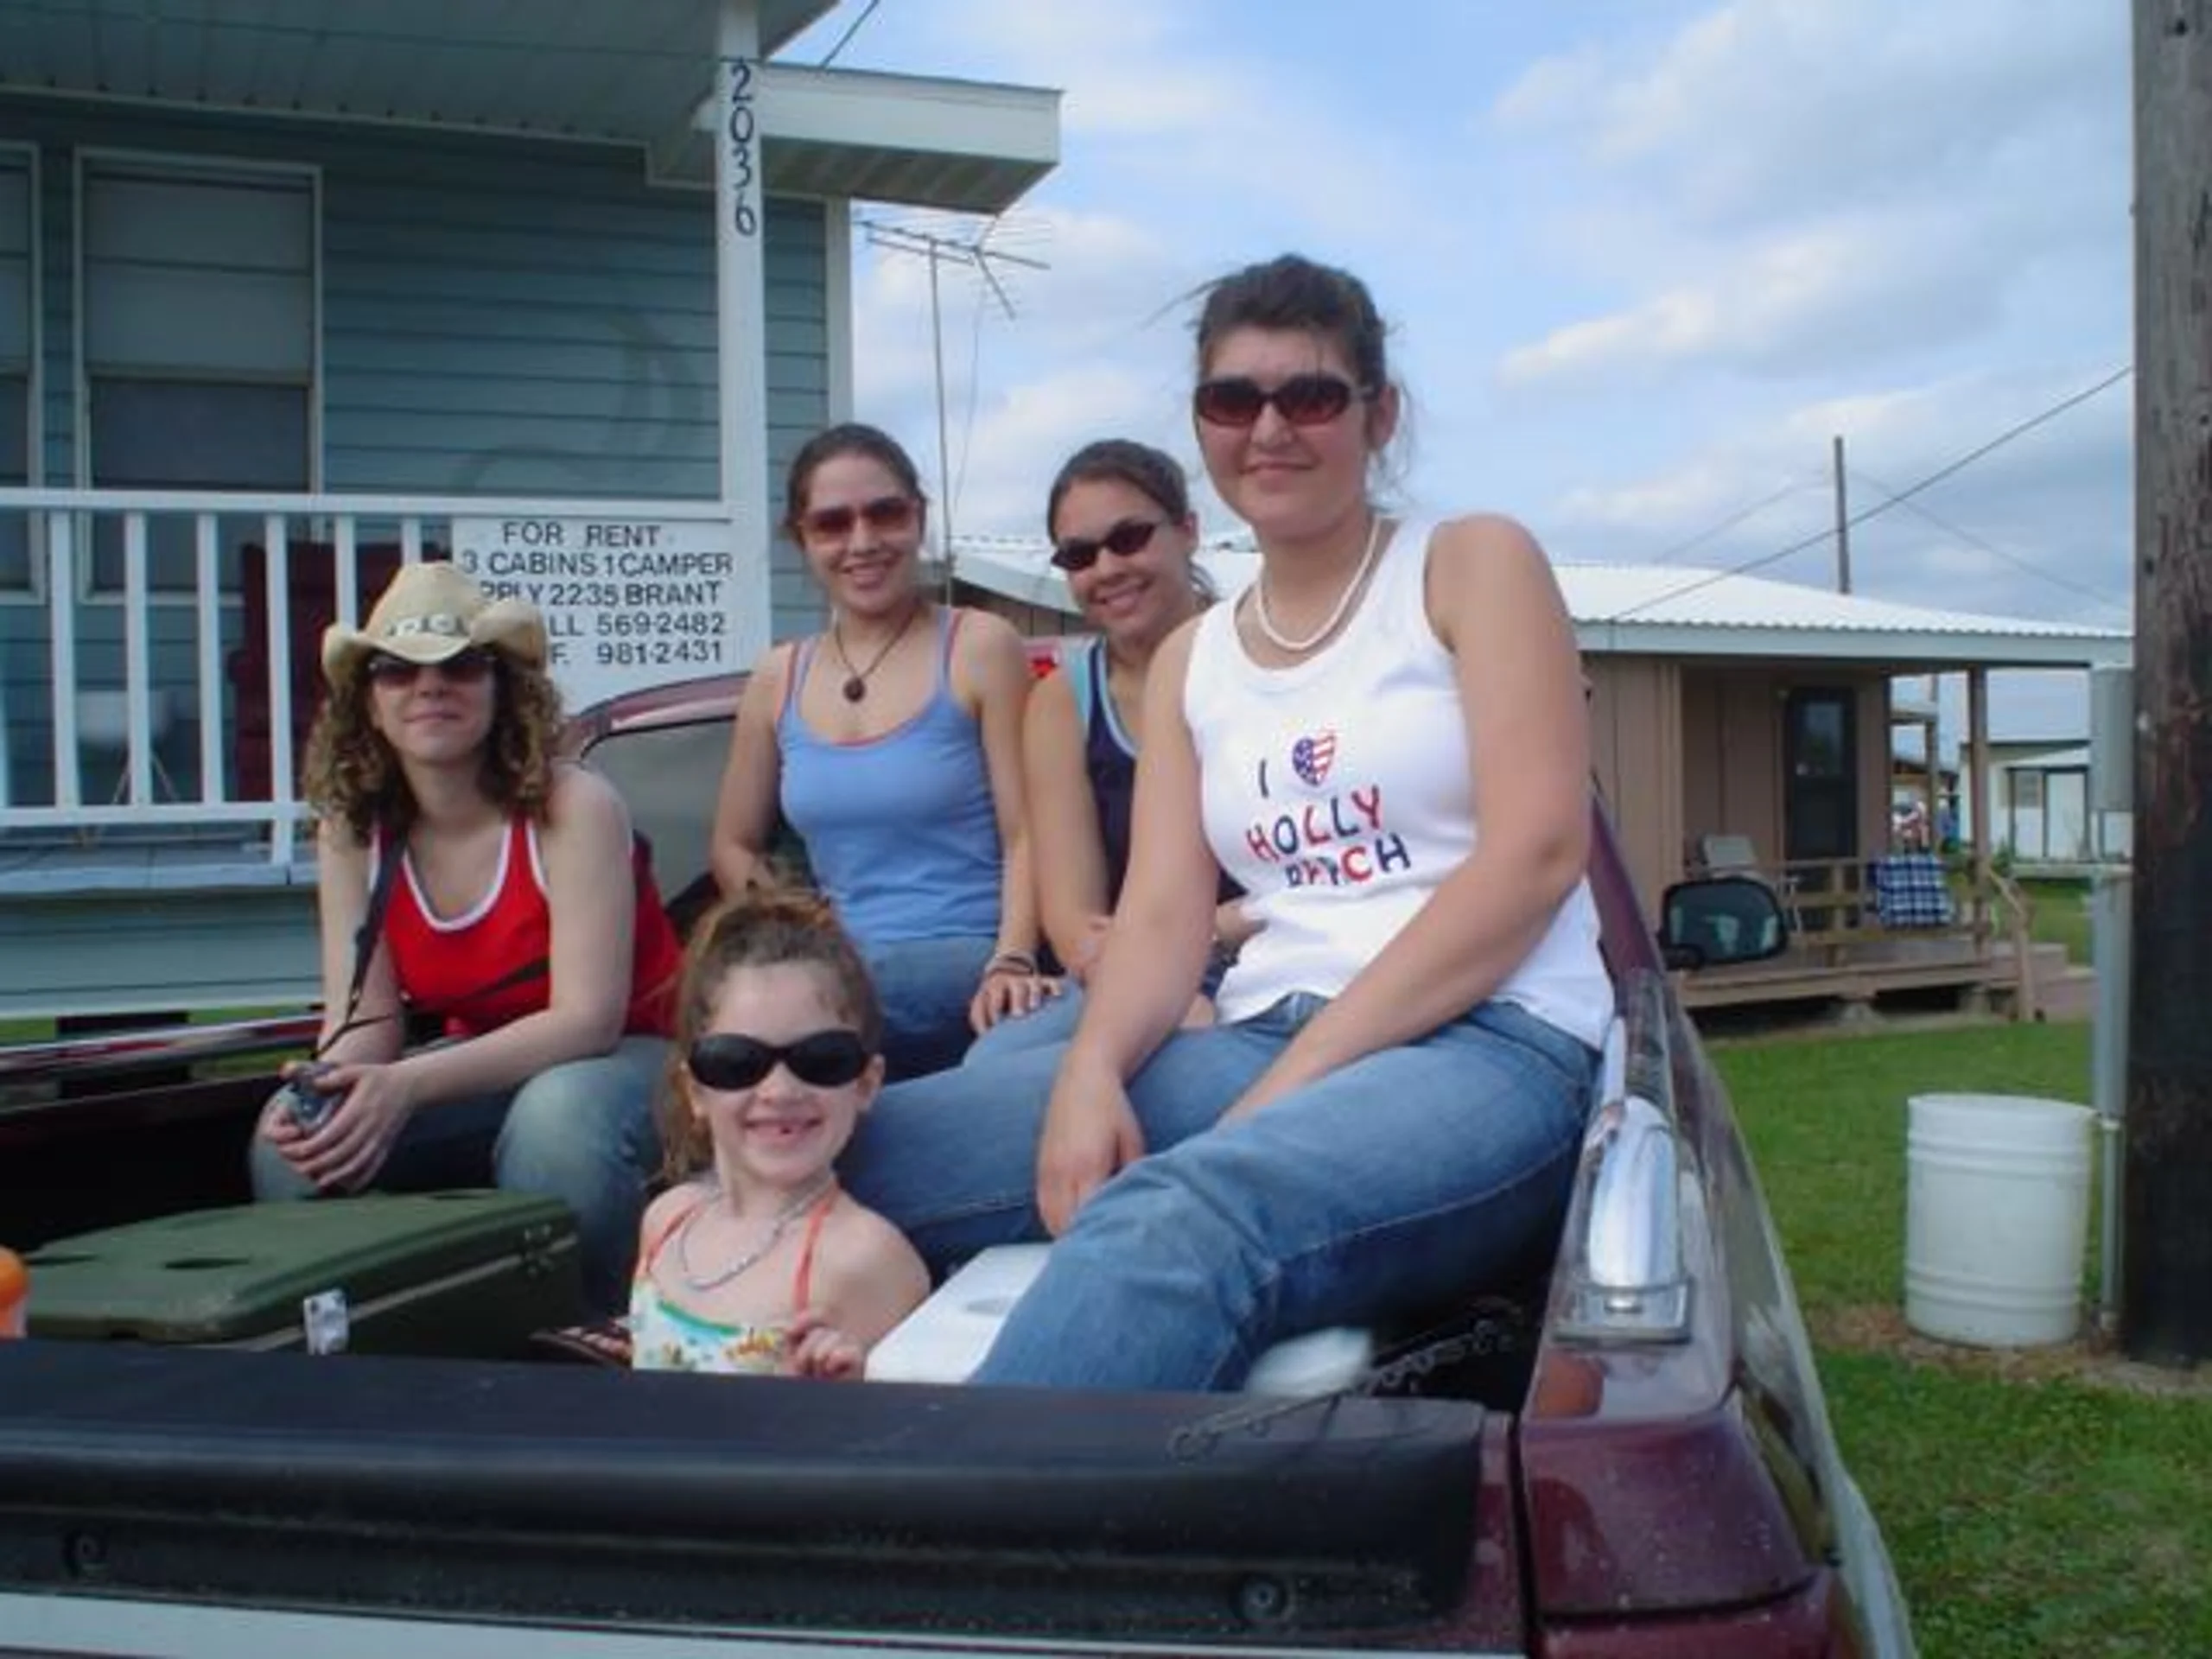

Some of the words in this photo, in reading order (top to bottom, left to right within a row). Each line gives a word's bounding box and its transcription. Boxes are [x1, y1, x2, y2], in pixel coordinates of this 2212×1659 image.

[729, 61, 756, 236] 2036
[502, 522, 564, 545] FOR
[585, 524, 661, 547] RENT
[461, 551, 479, 574] 3
[488, 552, 598, 576] CABINS
[604, 554, 614, 576] 1
[618, 552, 733, 576] CAMPER
[550, 583, 619, 606] 2235
[626, 581, 721, 605] BRANT
[1258, 758, 1269, 798] I
[1245, 783, 1381, 861] HOLLY
